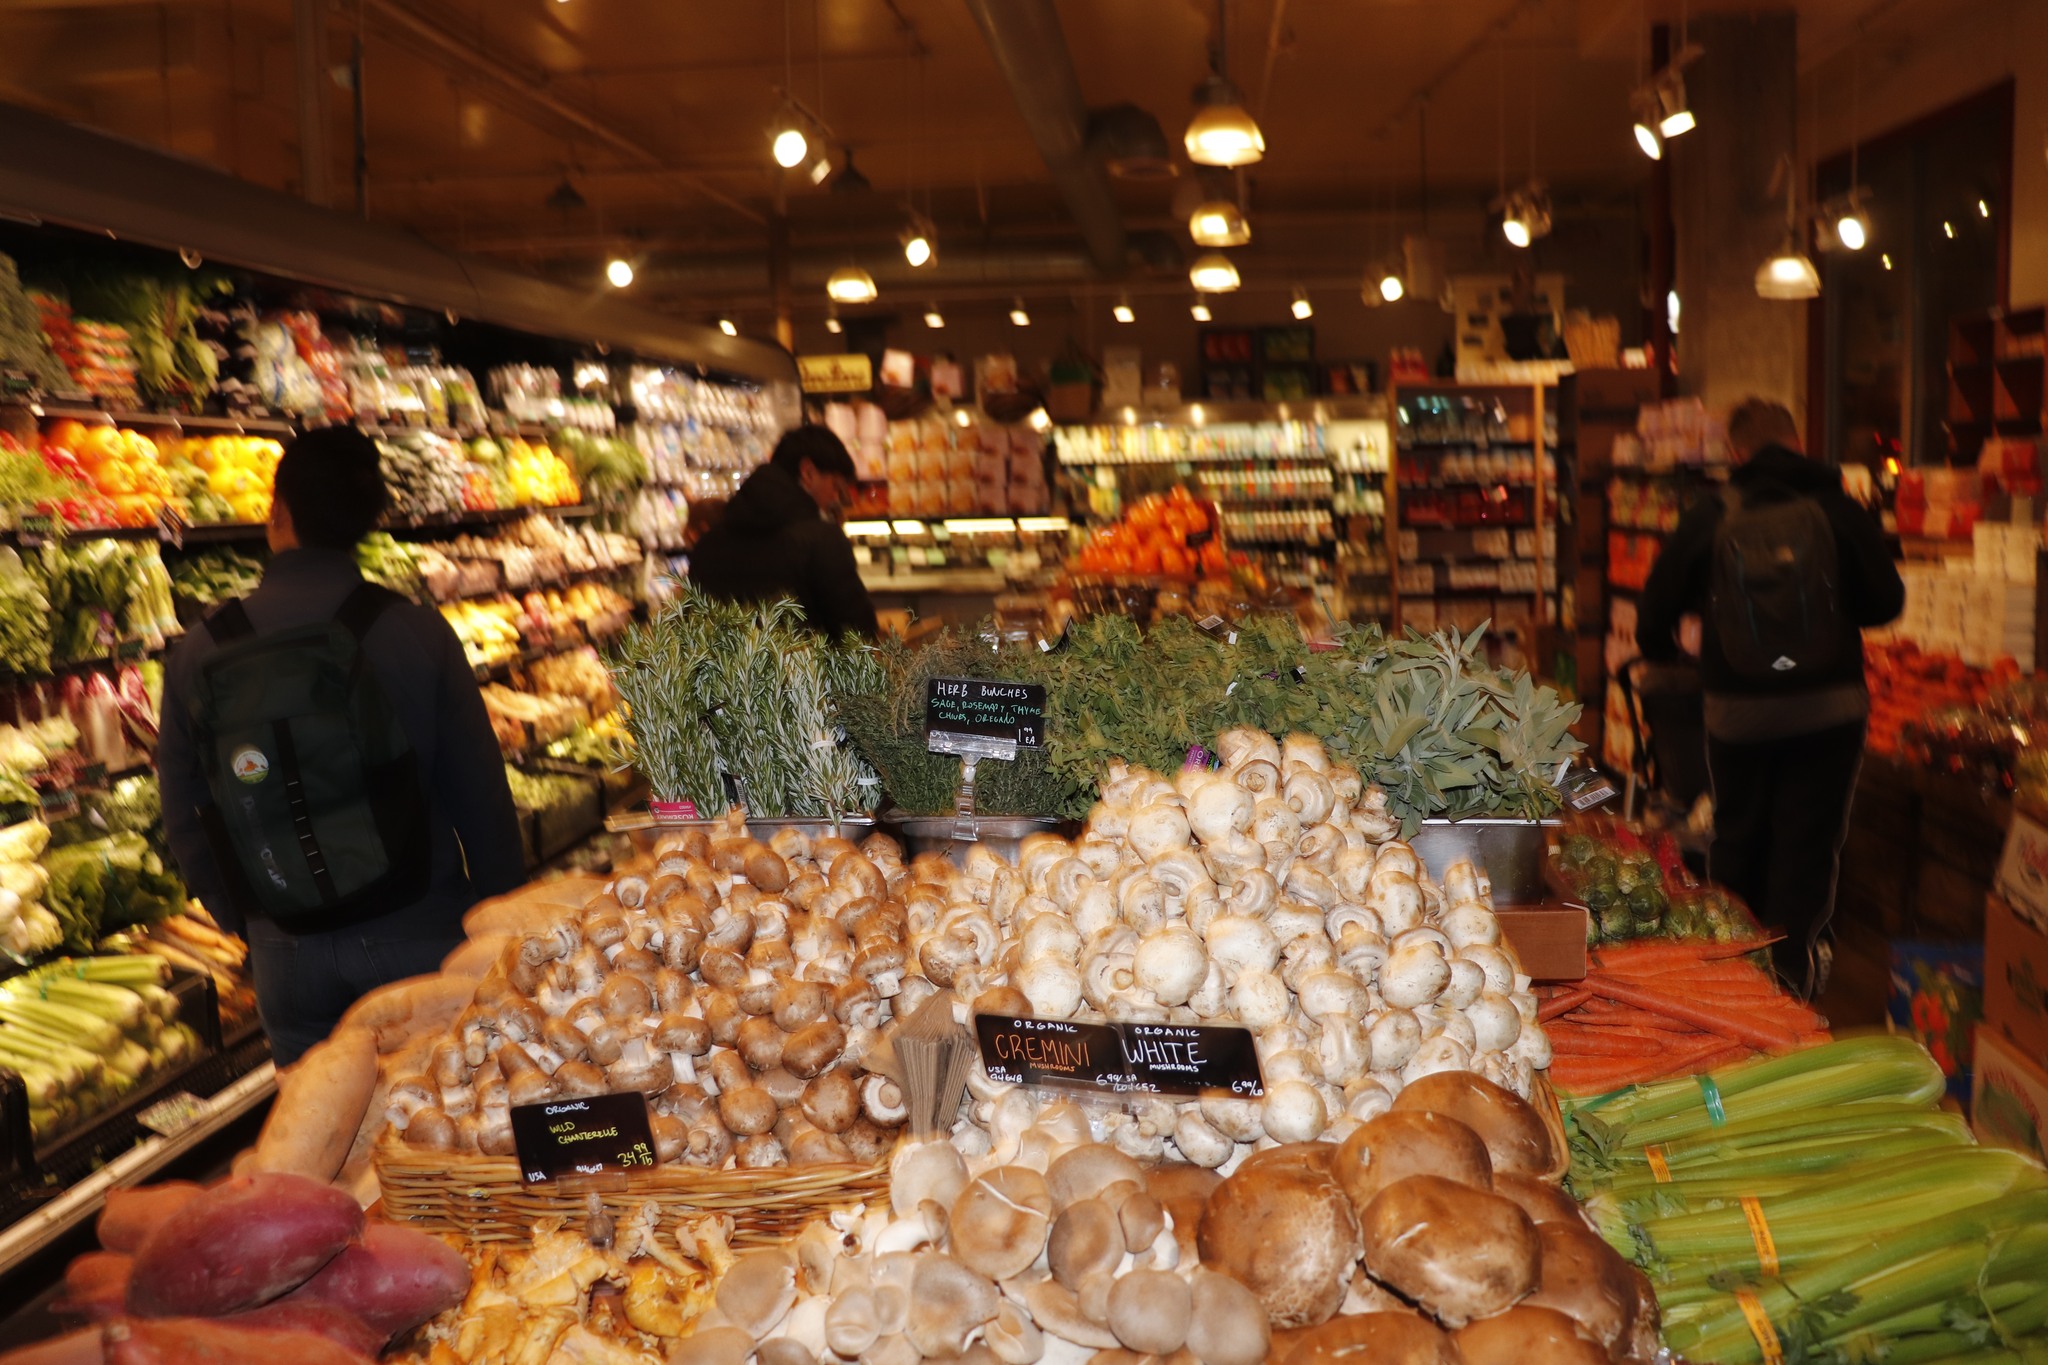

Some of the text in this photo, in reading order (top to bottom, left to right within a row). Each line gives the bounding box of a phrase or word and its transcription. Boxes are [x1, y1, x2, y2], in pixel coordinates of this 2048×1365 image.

[937, 681, 1028, 700] HERB BUNCHES
[1010, 704, 1041, 715] THYME
[974, 712, 1015, 725] OREGANO
[1025, 735, 1036, 745] EA
[1013, 1019, 1078, 1033] ORGANIC
[1135, 1026, 1200, 1037] ORGANIC
[995, 1034, 1090, 1067] CREMINI
[1122, 1038, 1208, 1064] WHITE
[988, 1065, 1007, 1074] USA
[1029, 1061, 1075, 1072] MUSHROOMS
[1149, 1063, 1200, 1073] MUSHROOMS
[989, 1073, 1023, 1083] 94648
[545, 1101, 590, 1115] ORGANIC
[549, 1121, 576, 1134] WILD
[557, 1126, 619, 1145] CHANTERELLE
[528, 1170, 547, 1183] USA
